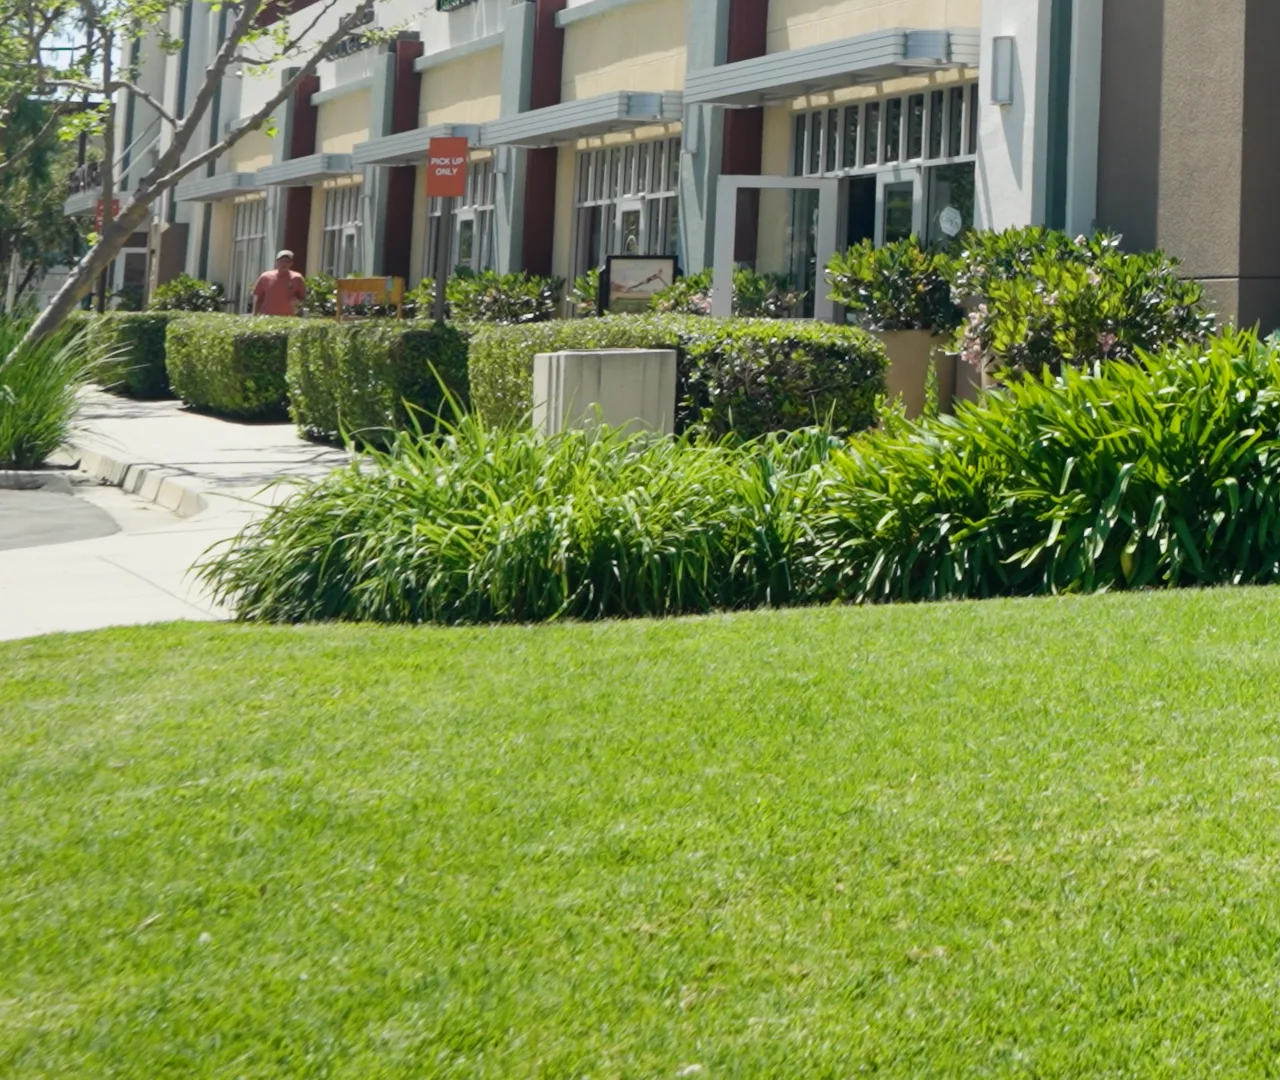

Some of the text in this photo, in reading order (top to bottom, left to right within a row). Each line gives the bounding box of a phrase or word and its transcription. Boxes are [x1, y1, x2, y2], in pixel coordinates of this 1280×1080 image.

[430, 156, 464, 165] PICK UP
[436, 167, 458, 176] ONLY
